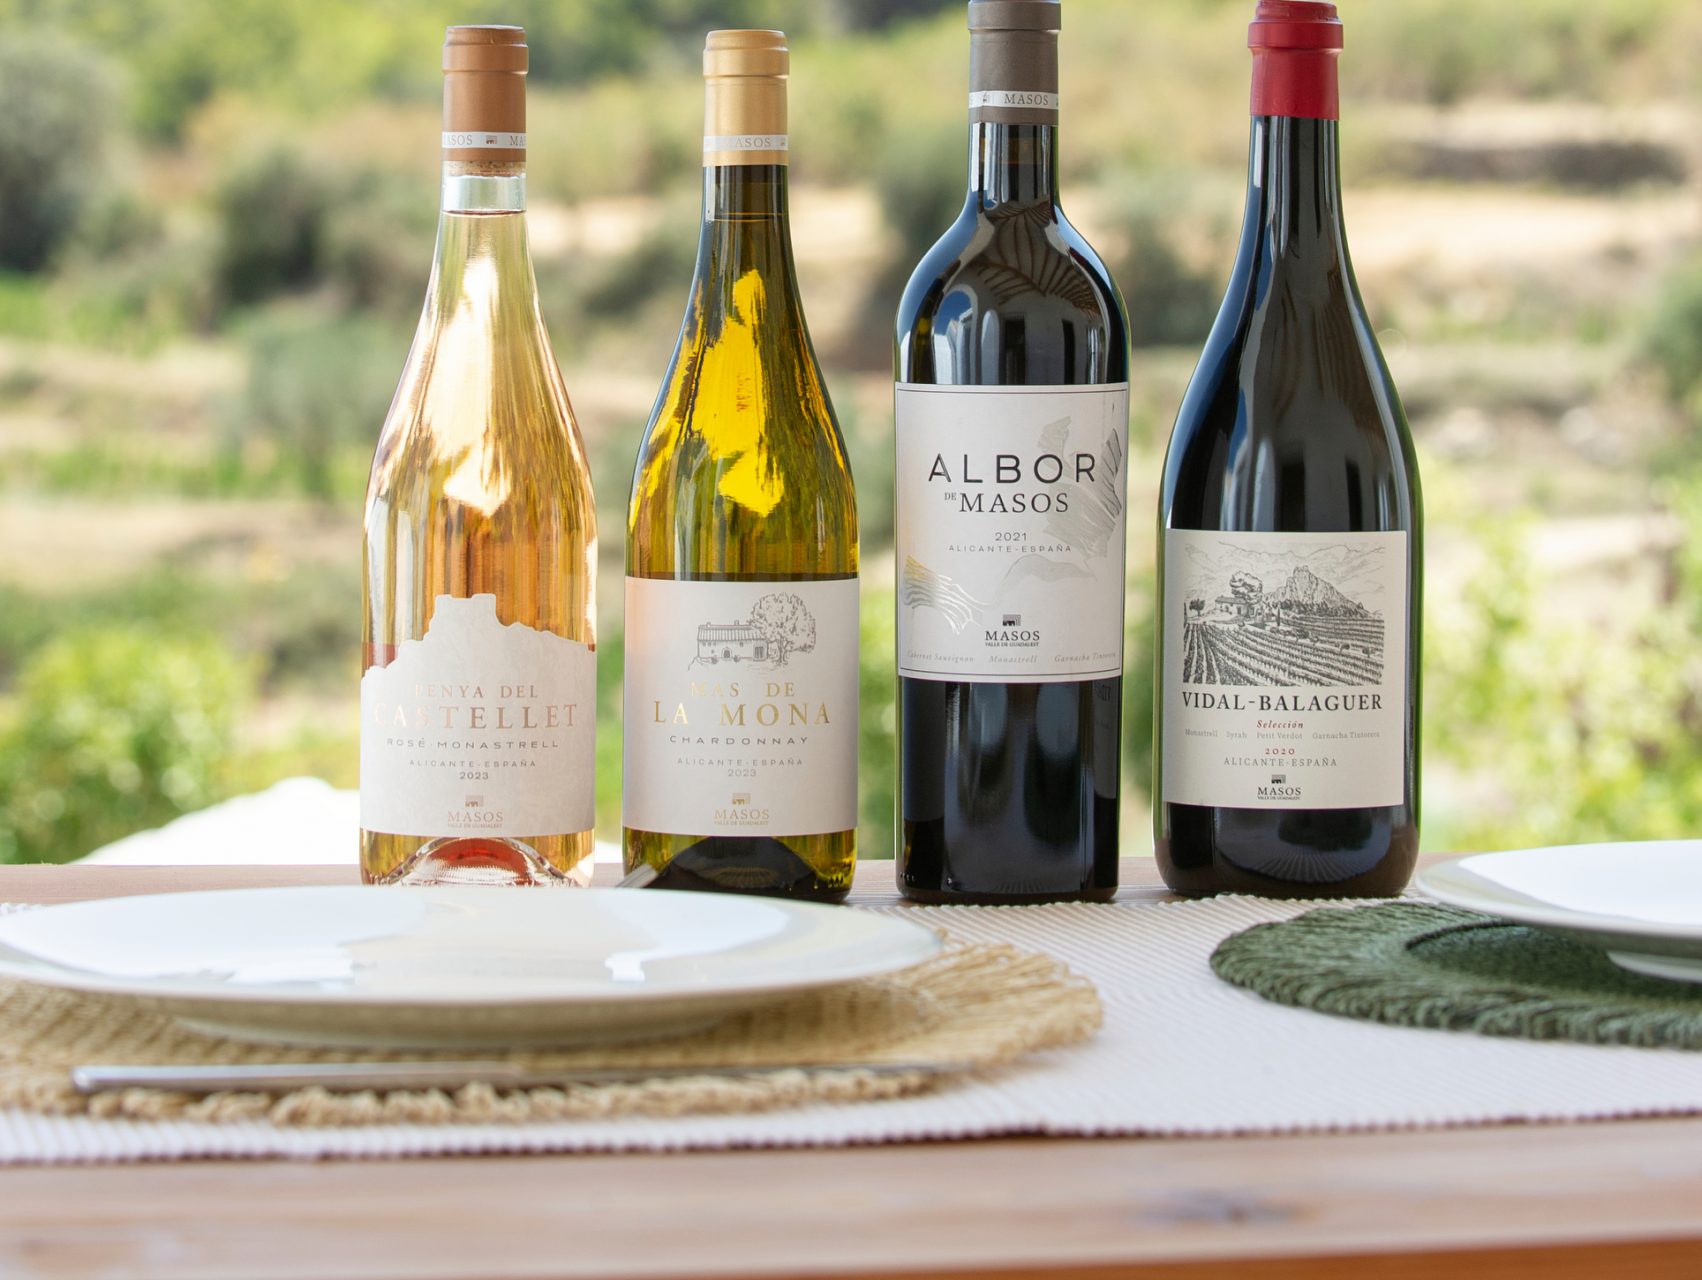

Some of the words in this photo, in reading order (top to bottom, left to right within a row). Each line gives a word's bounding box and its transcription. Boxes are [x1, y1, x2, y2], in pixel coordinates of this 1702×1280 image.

[1004, 93, 1049, 106] MASOS
[734, 137, 771, 148] ASOS
[928, 452, 1096, 484] ALBOR
[944, 492, 957, 501] DE
[958, 492, 1069, 513] MASOS
[994, 531, 1027, 541] 2021
[985, 630, 1040, 641] MASOS
[500, 684, 539, 699] DEL
[690, 681, 739, 697] MAS
[766, 681, 796, 697] DE
[1182, 691, 1383, 711] VIDAL-BALAGUER
[373, 703, 577, 729] CASTELLET
[653, 700, 689, 725] LA
[720, 701, 831, 726] MONA
[1256, 719, 1305, 729] Selección
[1256, 730, 1275, 739] Petit
[1277, 730, 1303, 739] Verdot
[387, 736, 425, 748] ROSÉ
[437, 740, 559, 749] MONASTRELL
[669, 735, 809, 746] CHARDONNAY
[1264, 747, 1296, 756] 2020
[459, 771, 489, 780] 2023
[727, 768, 757, 777] 2023
[1258, 786, 1301, 796] MASOS
[447, 811, 503, 822] MASOS
[714, 808, 770, 819] MASOS
